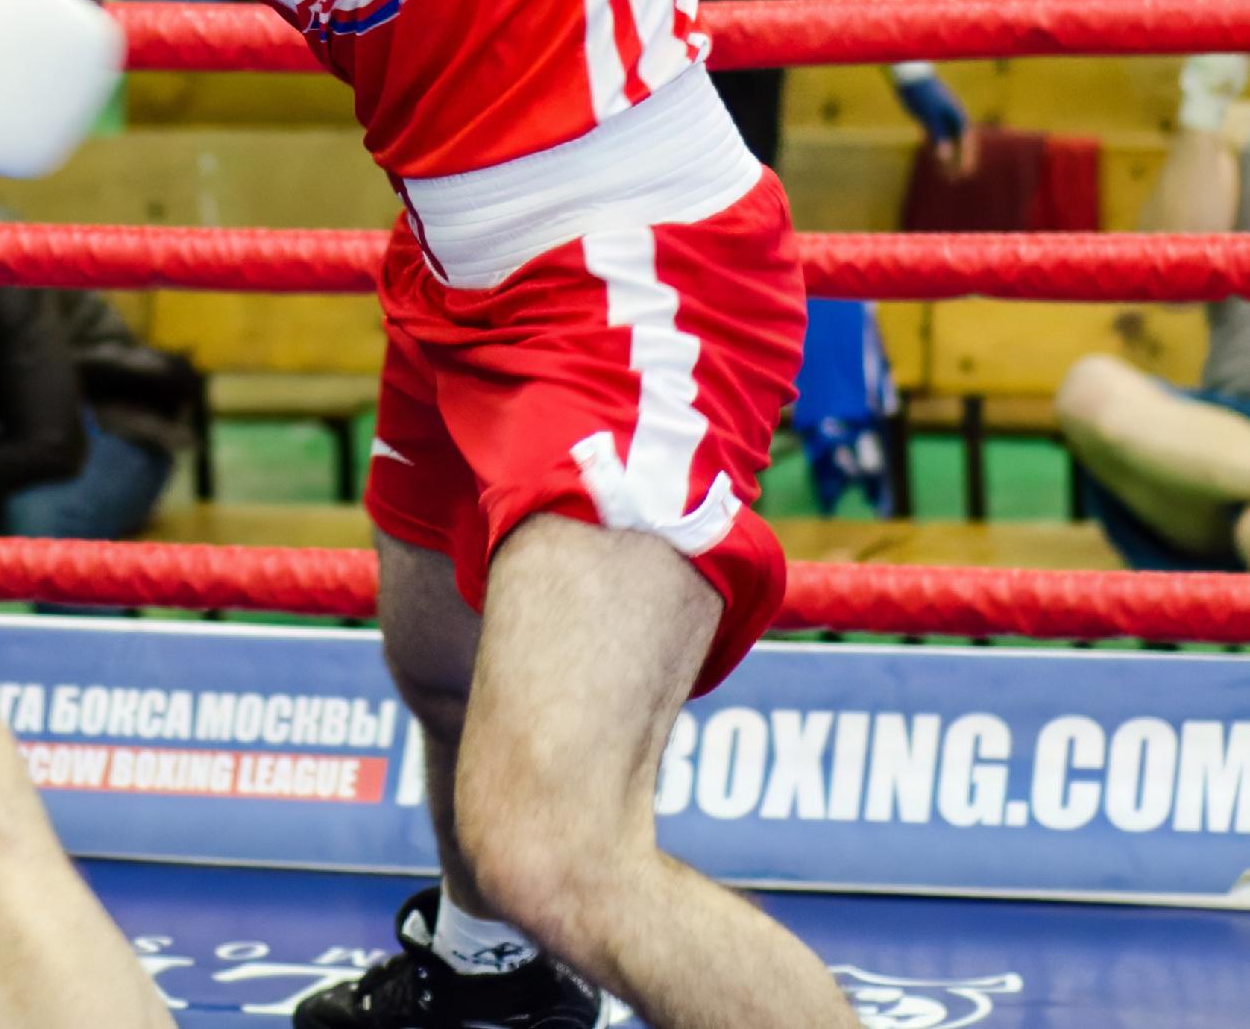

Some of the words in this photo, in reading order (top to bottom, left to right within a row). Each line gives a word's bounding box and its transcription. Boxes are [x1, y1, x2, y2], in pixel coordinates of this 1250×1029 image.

[51, 683, 193, 740] БОКСА
[195, 689, 398, 748] МОСКВЫ
[109, 748, 235, 794] BOXING
[236, 754, 362, 799] LEAGUE
